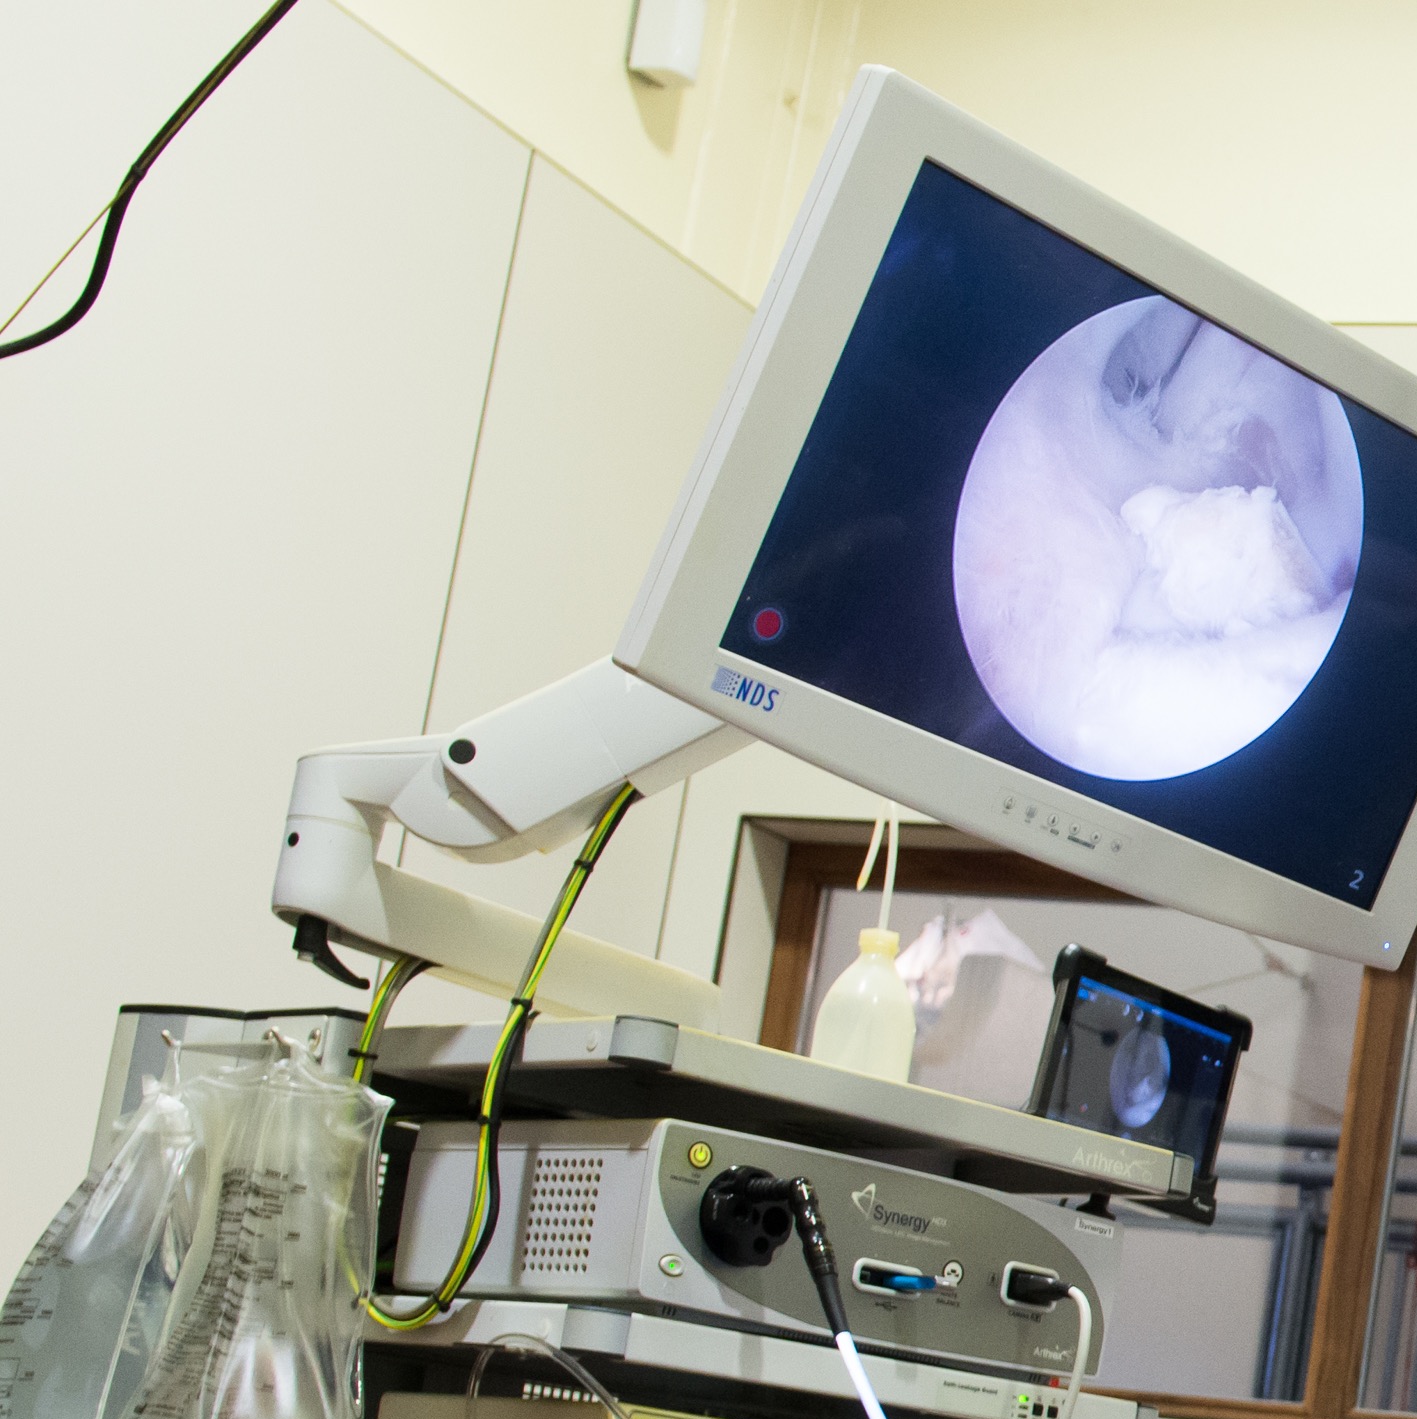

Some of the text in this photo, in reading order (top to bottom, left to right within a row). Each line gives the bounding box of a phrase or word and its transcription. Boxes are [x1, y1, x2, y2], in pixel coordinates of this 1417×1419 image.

[735, 677, 780, 712] NDS
[1348, 869, 1365, 890] 2
[1071, 1146, 1132, 1179] Arthrex
[873, 1204, 931, 1234] Synergy
